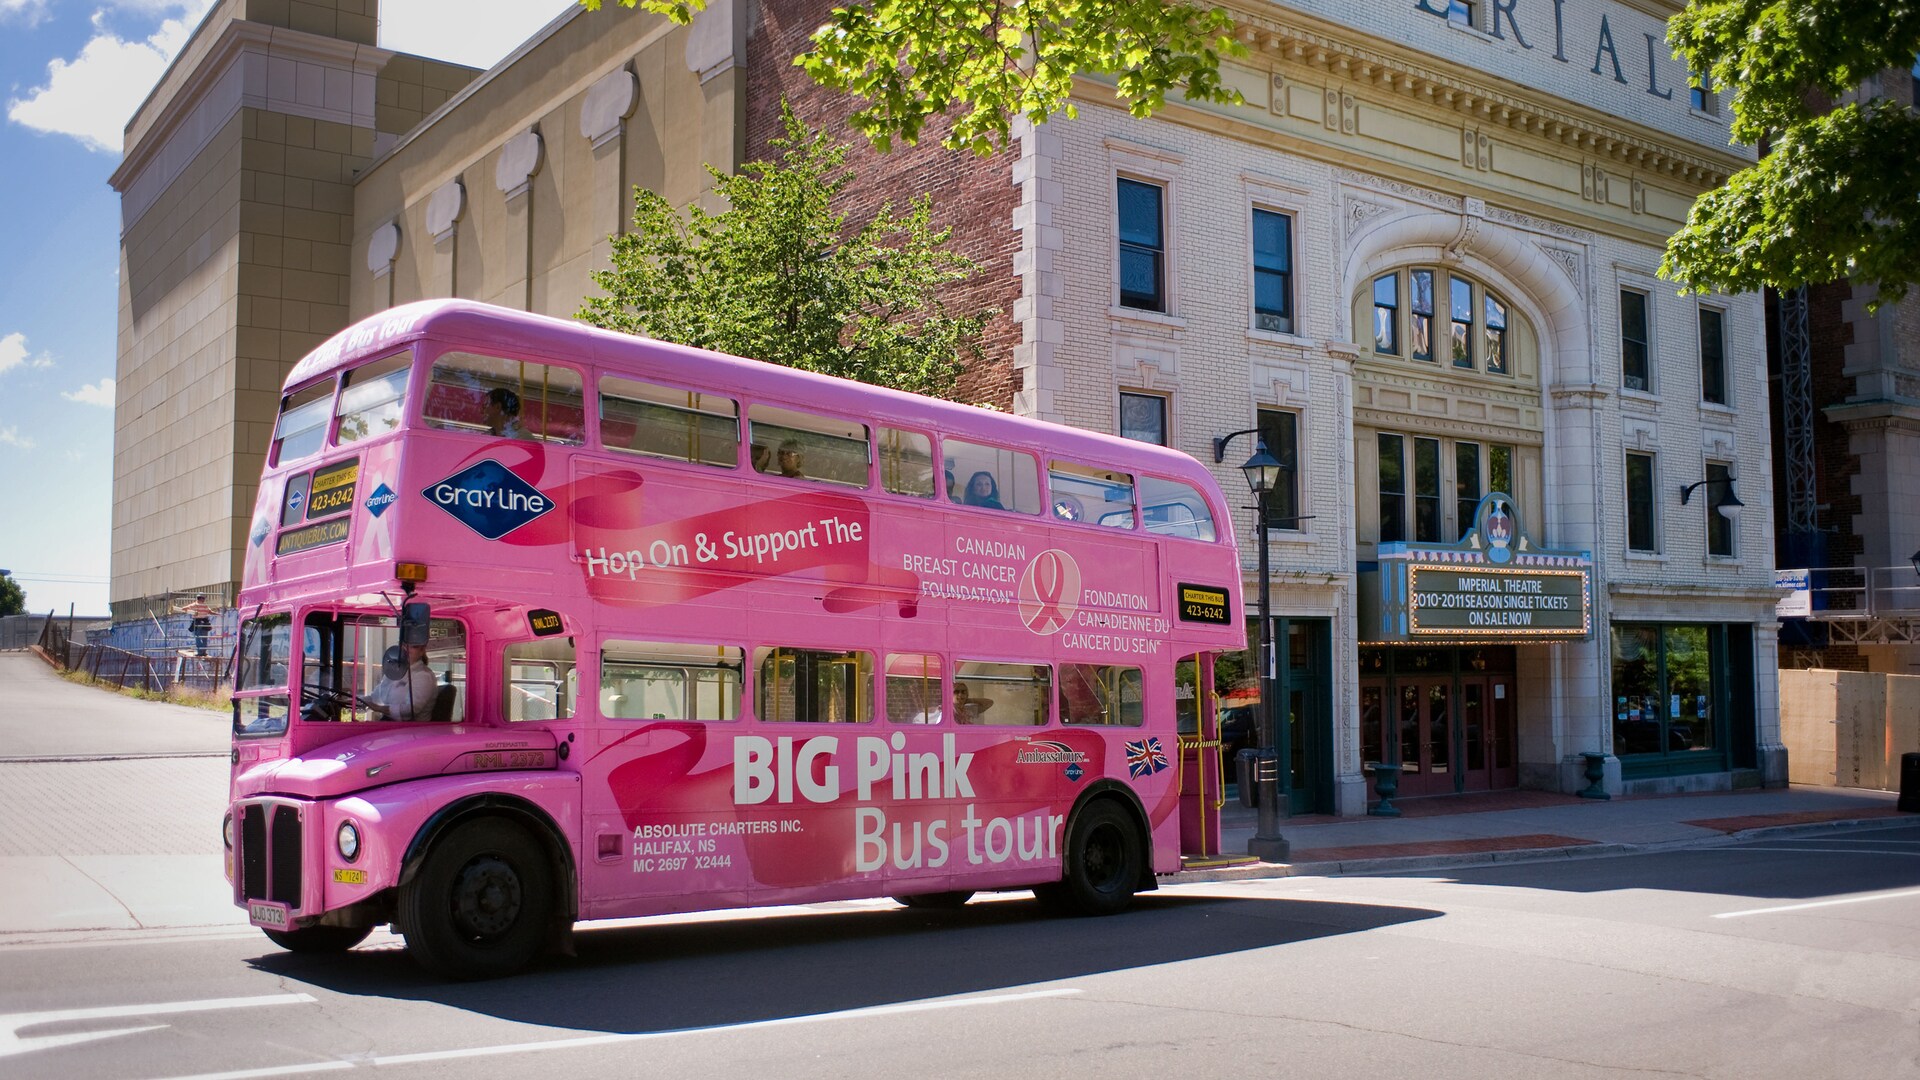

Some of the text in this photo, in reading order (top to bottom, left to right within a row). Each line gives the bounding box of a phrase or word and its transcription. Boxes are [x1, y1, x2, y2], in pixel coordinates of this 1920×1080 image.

[1414, 0, 1673, 101] RIAL
[314, 474, 336, 488] CHARTER
[336, 472, 348, 483] THIS
[311, 487, 354, 511] 423-6242
[585, 516, 863, 581] Hop On & Support The
[956, 536, 1026, 560] CANADIAN
[903, 553, 1016, 583] BREAST CANCER
[1458, 577, 1542, 593] IMPERIAL THEATRE
[1084, 589, 1148, 610] FONDATION
[1503, 595, 1533, 609] SINGLE
[1535, 596, 1568, 609] TICKETS
[1078, 611, 1169, 633] CANADIENNE DU
[1186, 605, 1224, 619] 423-6242
[1469, 611, 1532, 625] ON SALE NOW
[533, 616, 559, 630] RML 2373
[1063, 632, 1111, 651] CANCER
[1113, 636, 1129, 652] DU
[485, 741, 529, 749] ROUTEMASTER
[473, 751, 545, 768] RML 2373
[733, 731, 976, 805] BIG Pink
[633, 819, 804, 839] ABSOLUTE CHARTERS INC.
[855, 803, 1063, 873] Bus tour
[633, 839, 716, 855] HALIFAX, NS
[633, 854, 731, 873] MC 2697 X2444
